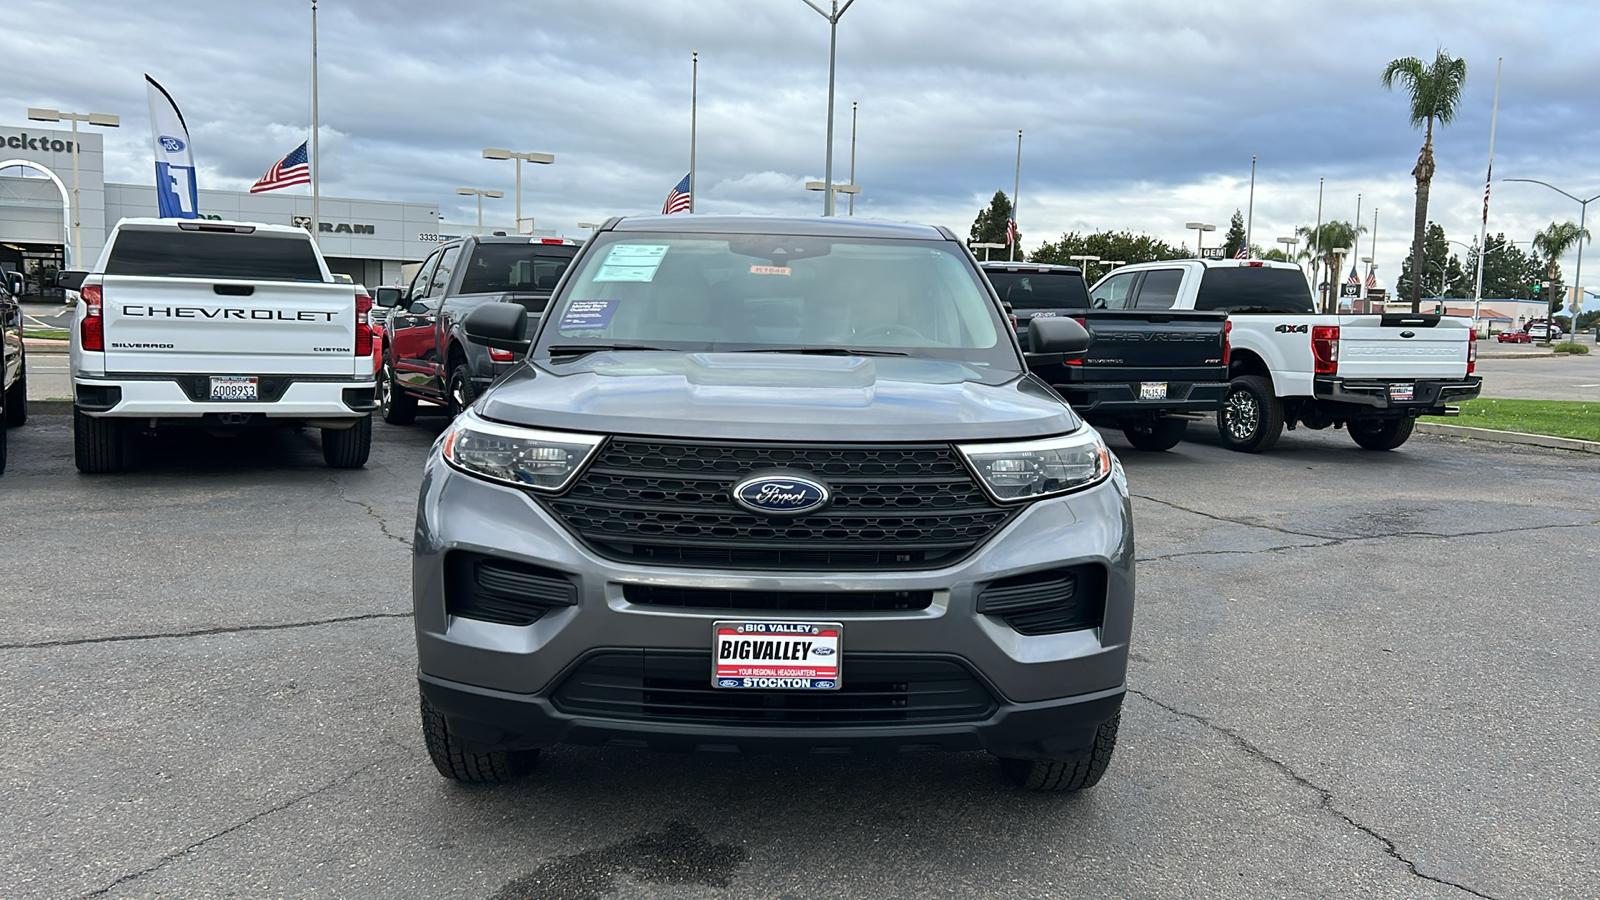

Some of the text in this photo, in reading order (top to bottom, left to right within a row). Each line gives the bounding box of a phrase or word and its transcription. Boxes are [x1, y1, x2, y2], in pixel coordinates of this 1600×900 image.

[318, 222, 375, 235] RAM
[419, 233, 438, 242] 3333
[1203, 248, 1224, 257] OEM
[122, 305, 339, 322] CHEVROLET
[1096, 331, 1218, 342] CHEVROLET
[1348, 346, 1459, 356] SUPER DUTY
[213, 385, 255, 396] 60089S3
[755, 483, 807, 505] Ford
[745, 623, 811, 633] BIG VALLEY
[720, 640, 833, 660] BIGVALLEY Ford
[738, 668, 752, 676] YOUR
[777, 669, 816, 677] HEADQUARTERS
[743, 678, 811, 688] STOCKTON
